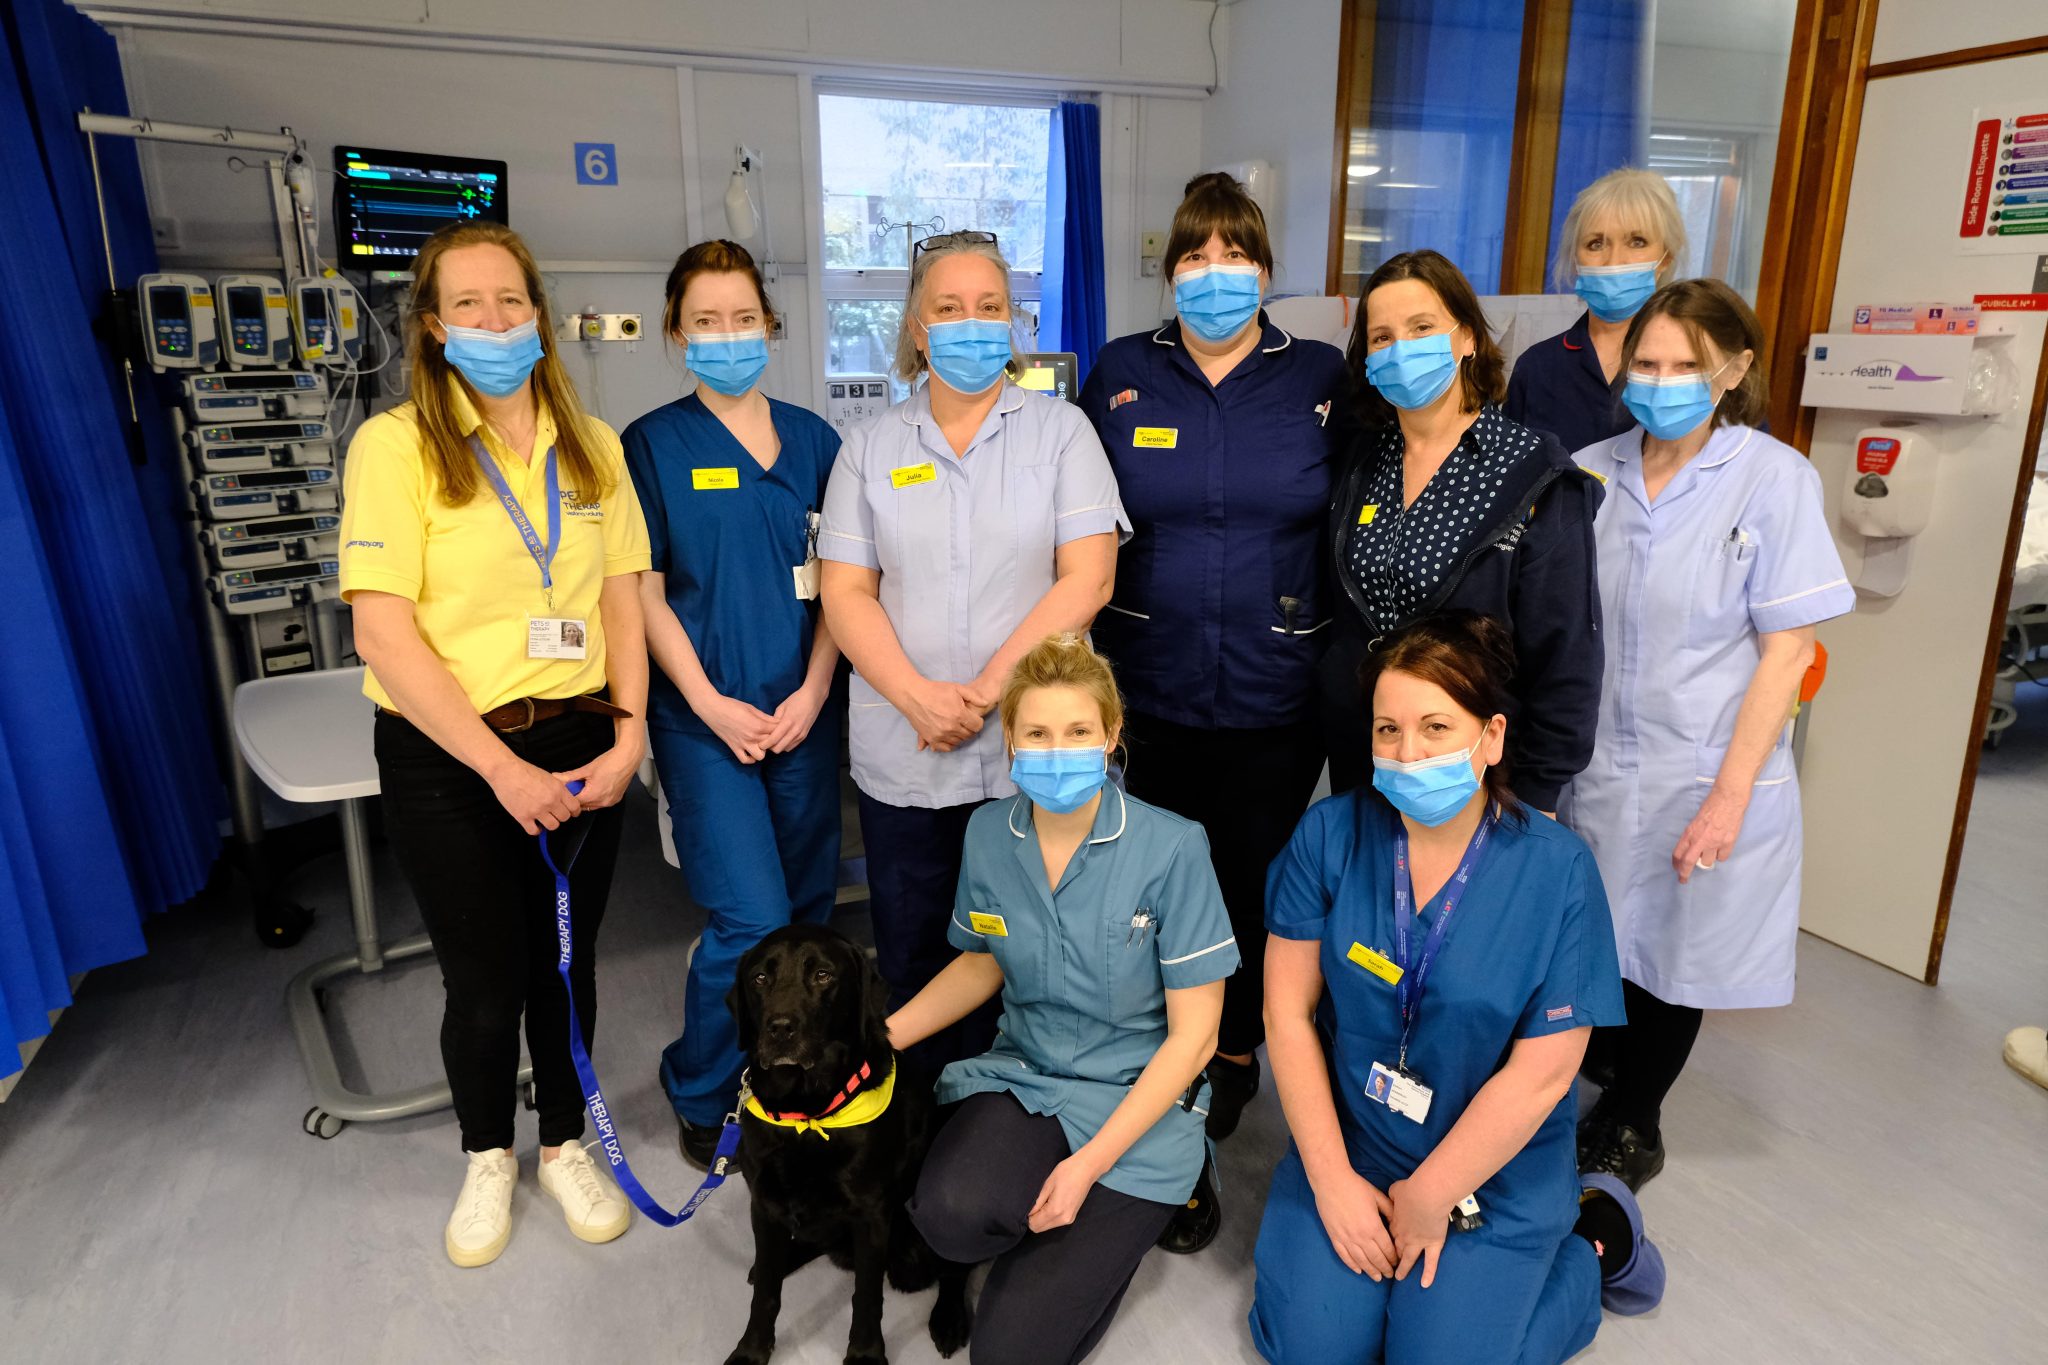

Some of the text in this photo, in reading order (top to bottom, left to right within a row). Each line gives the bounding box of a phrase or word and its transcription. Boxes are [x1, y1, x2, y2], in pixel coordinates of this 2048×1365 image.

[585, 150, 608, 181] 6
[1967, 133, 1990, 225] Side Room Etiquette
[1982, 300, 2018, 308] CUBICLE
[852, 385, 861, 396] 3
[854, 406, 863, 414] 12
[835, 418, 845, 427] 10
[906, 473, 922, 481] Julia
[563, 502, 601, 510] THERAP
[502, 494, 532, 537] THERAPY
[558, 891, 571, 964] THERAPY DOG
[588, 1090, 624, 1166] THERAPY DOG
